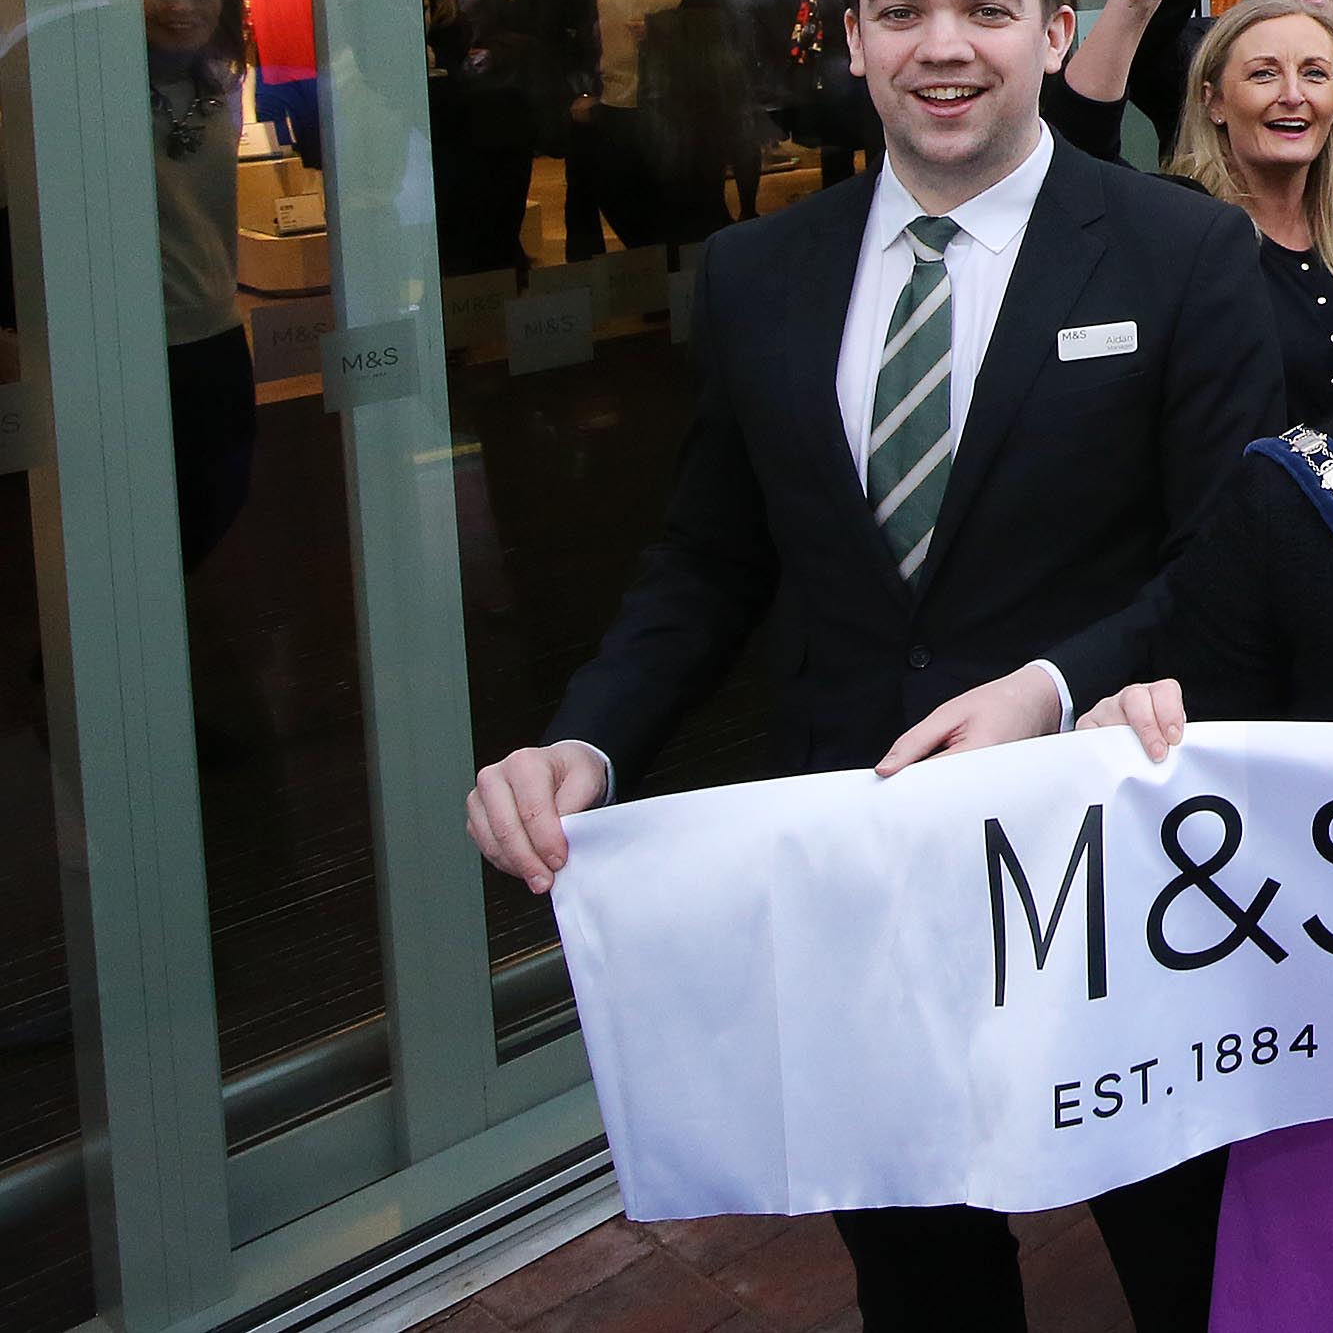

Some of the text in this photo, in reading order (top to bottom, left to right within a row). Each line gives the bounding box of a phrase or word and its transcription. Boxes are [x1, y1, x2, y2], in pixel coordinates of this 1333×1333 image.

[1062, 329, 1087, 342] M&S
[1106, 335, 1134, 344] Aidan
[341, 346, 399, 375] M&S
[1055, 1024, 1318, 1129] EST. 1884
